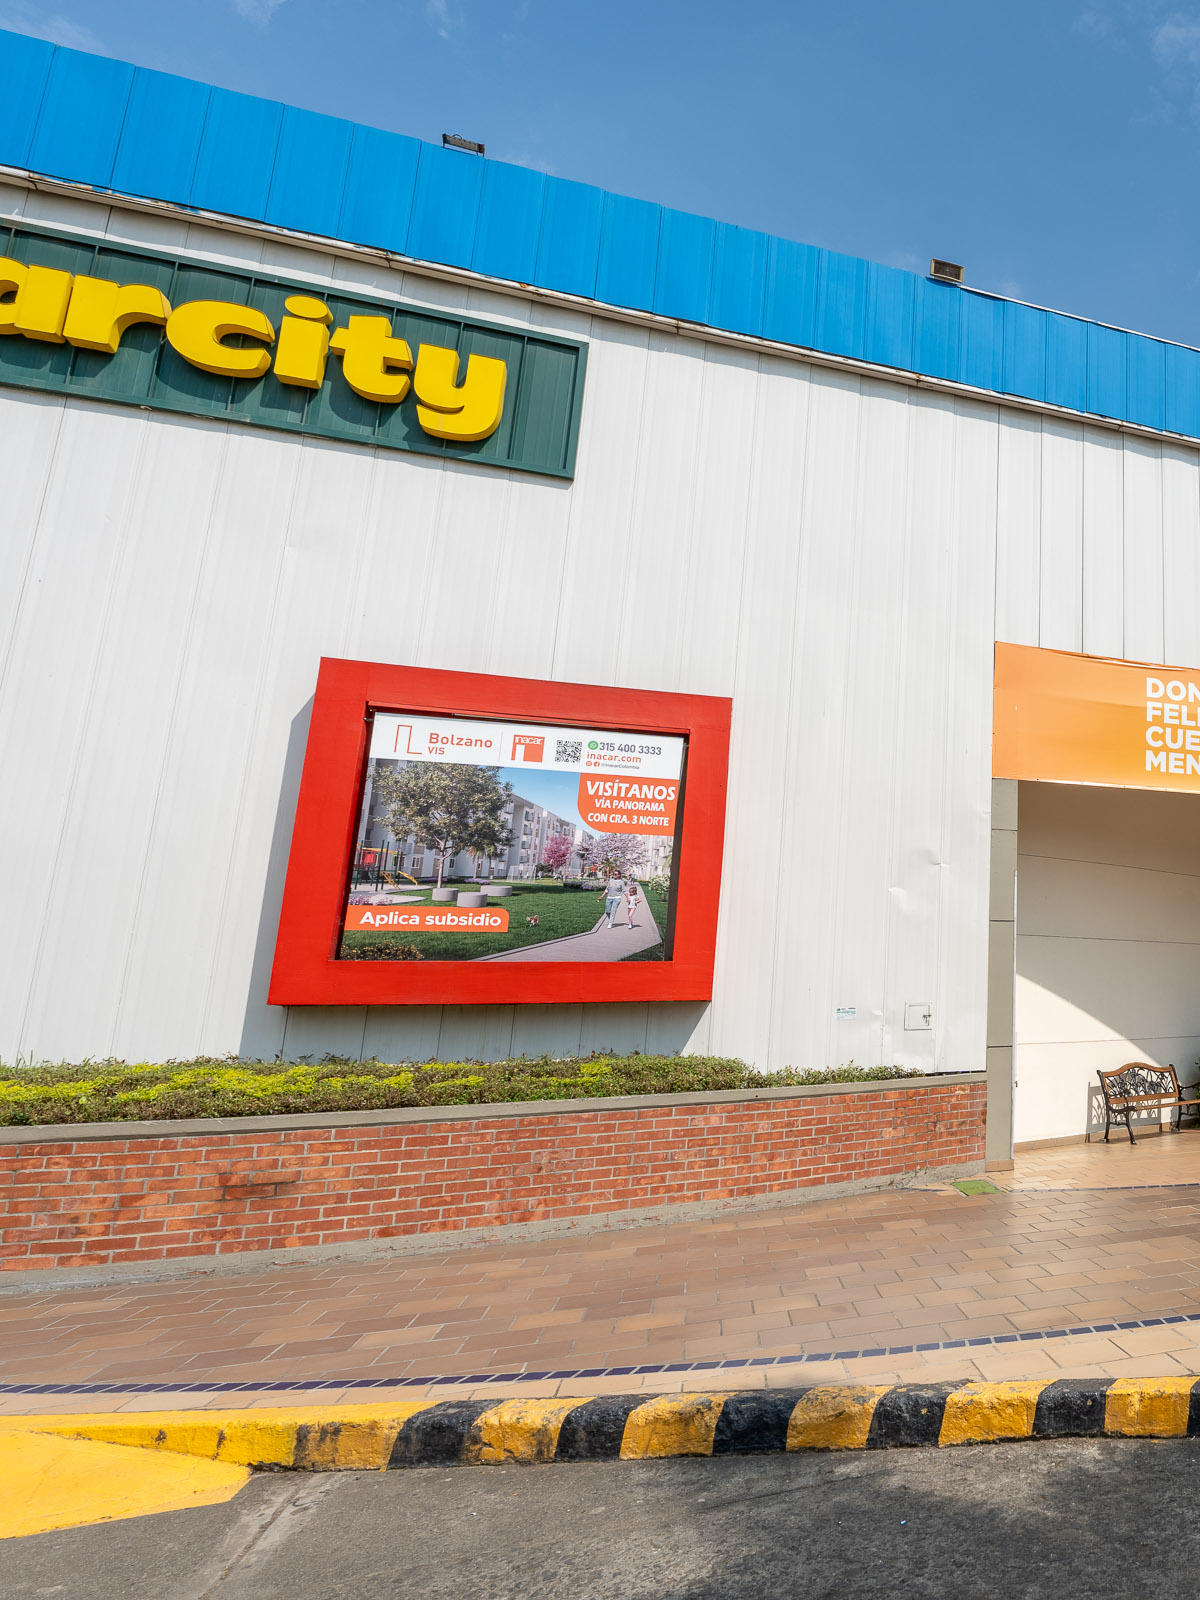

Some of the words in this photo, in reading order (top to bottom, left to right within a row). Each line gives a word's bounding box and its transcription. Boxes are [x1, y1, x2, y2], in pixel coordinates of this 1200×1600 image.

[428, 732, 493, 748] Bolzano
[427, 746, 445, 755] VIS
[599, 742, 615, 752] 315
[617, 743, 636, 753] 400
[638, 745, 662, 755] 3333
[586, 752, 642, 763] inacar.com
[586, 779, 676, 801] VISÍTANOS
[594, 797, 611, 809] VÍA
[612, 799, 665, 812] PANORAMA
[587, 812, 608, 822] CON
[609, 813, 630, 824] CRA.
[632, 815, 638, 824] 3
[639, 816, 670, 827] NORTE
[359, 911, 420, 927] Aplica
[424, 912, 502, 926] subsidio
